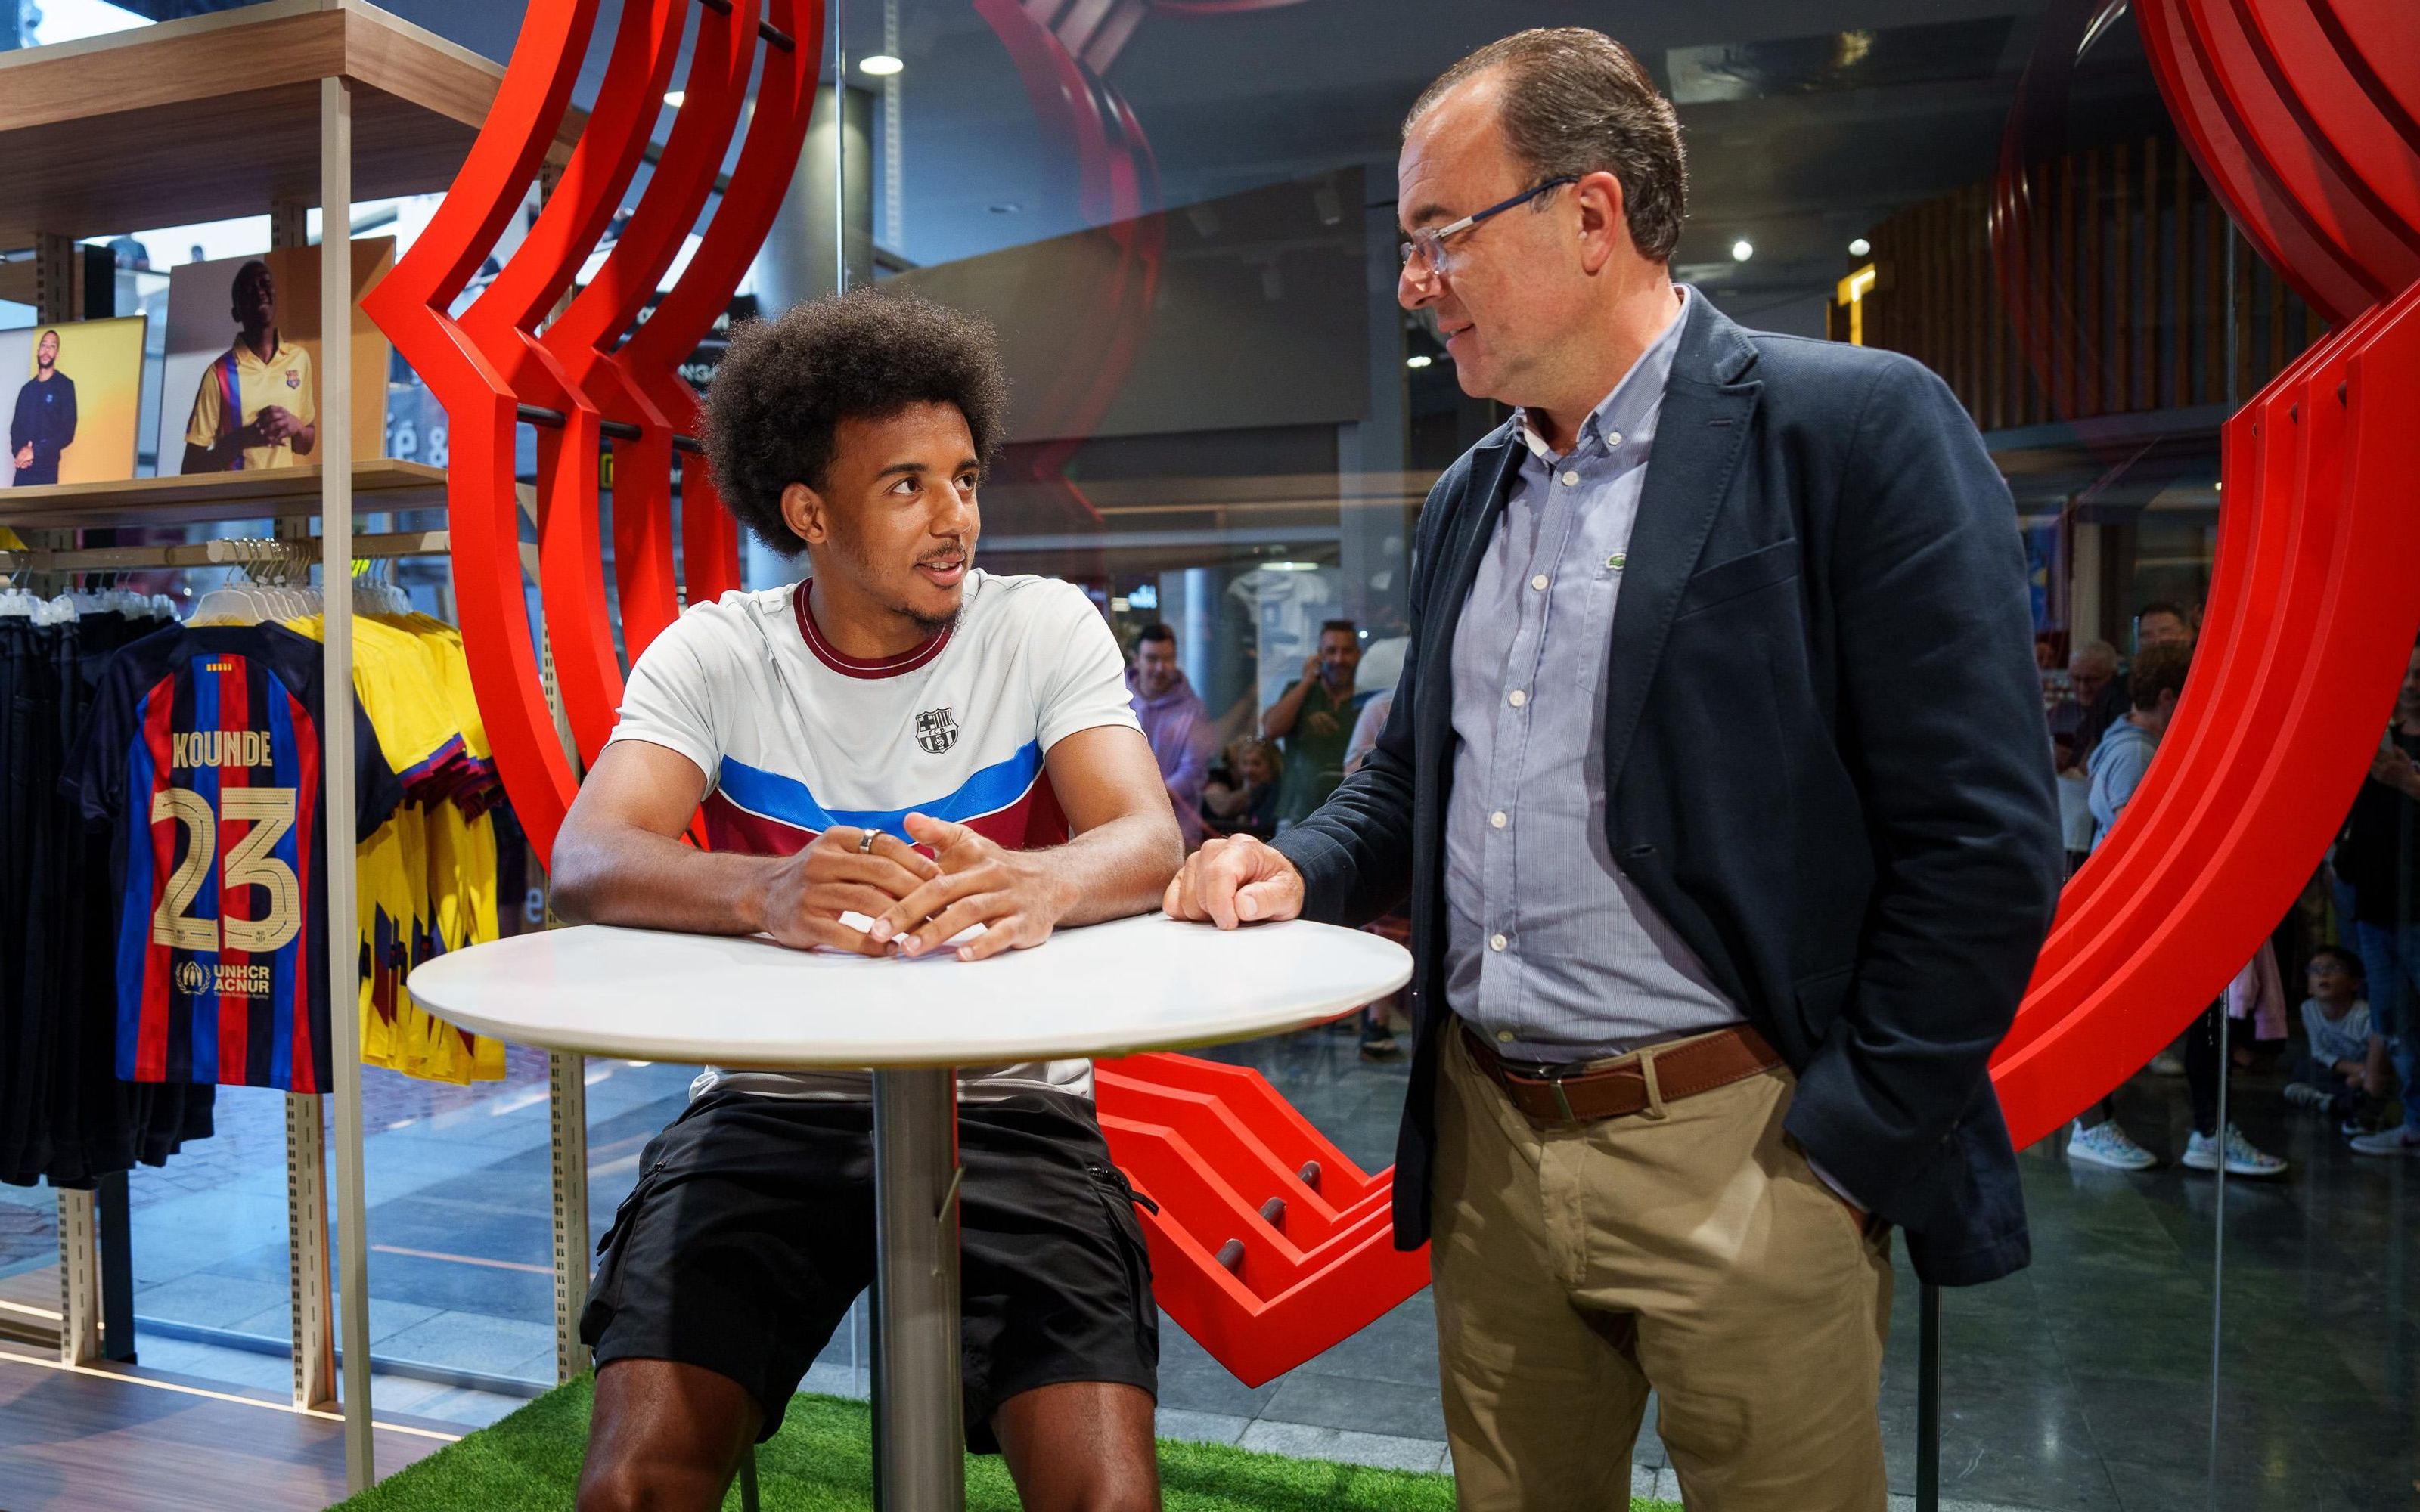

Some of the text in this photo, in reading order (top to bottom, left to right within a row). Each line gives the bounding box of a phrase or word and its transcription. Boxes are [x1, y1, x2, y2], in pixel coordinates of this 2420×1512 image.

[172, 731, 273, 768] KOUNDE
[151, 787, 302, 953] 23
[213, 964, 270, 979] UNHCR
[213, 978, 270, 993] ACNUR
